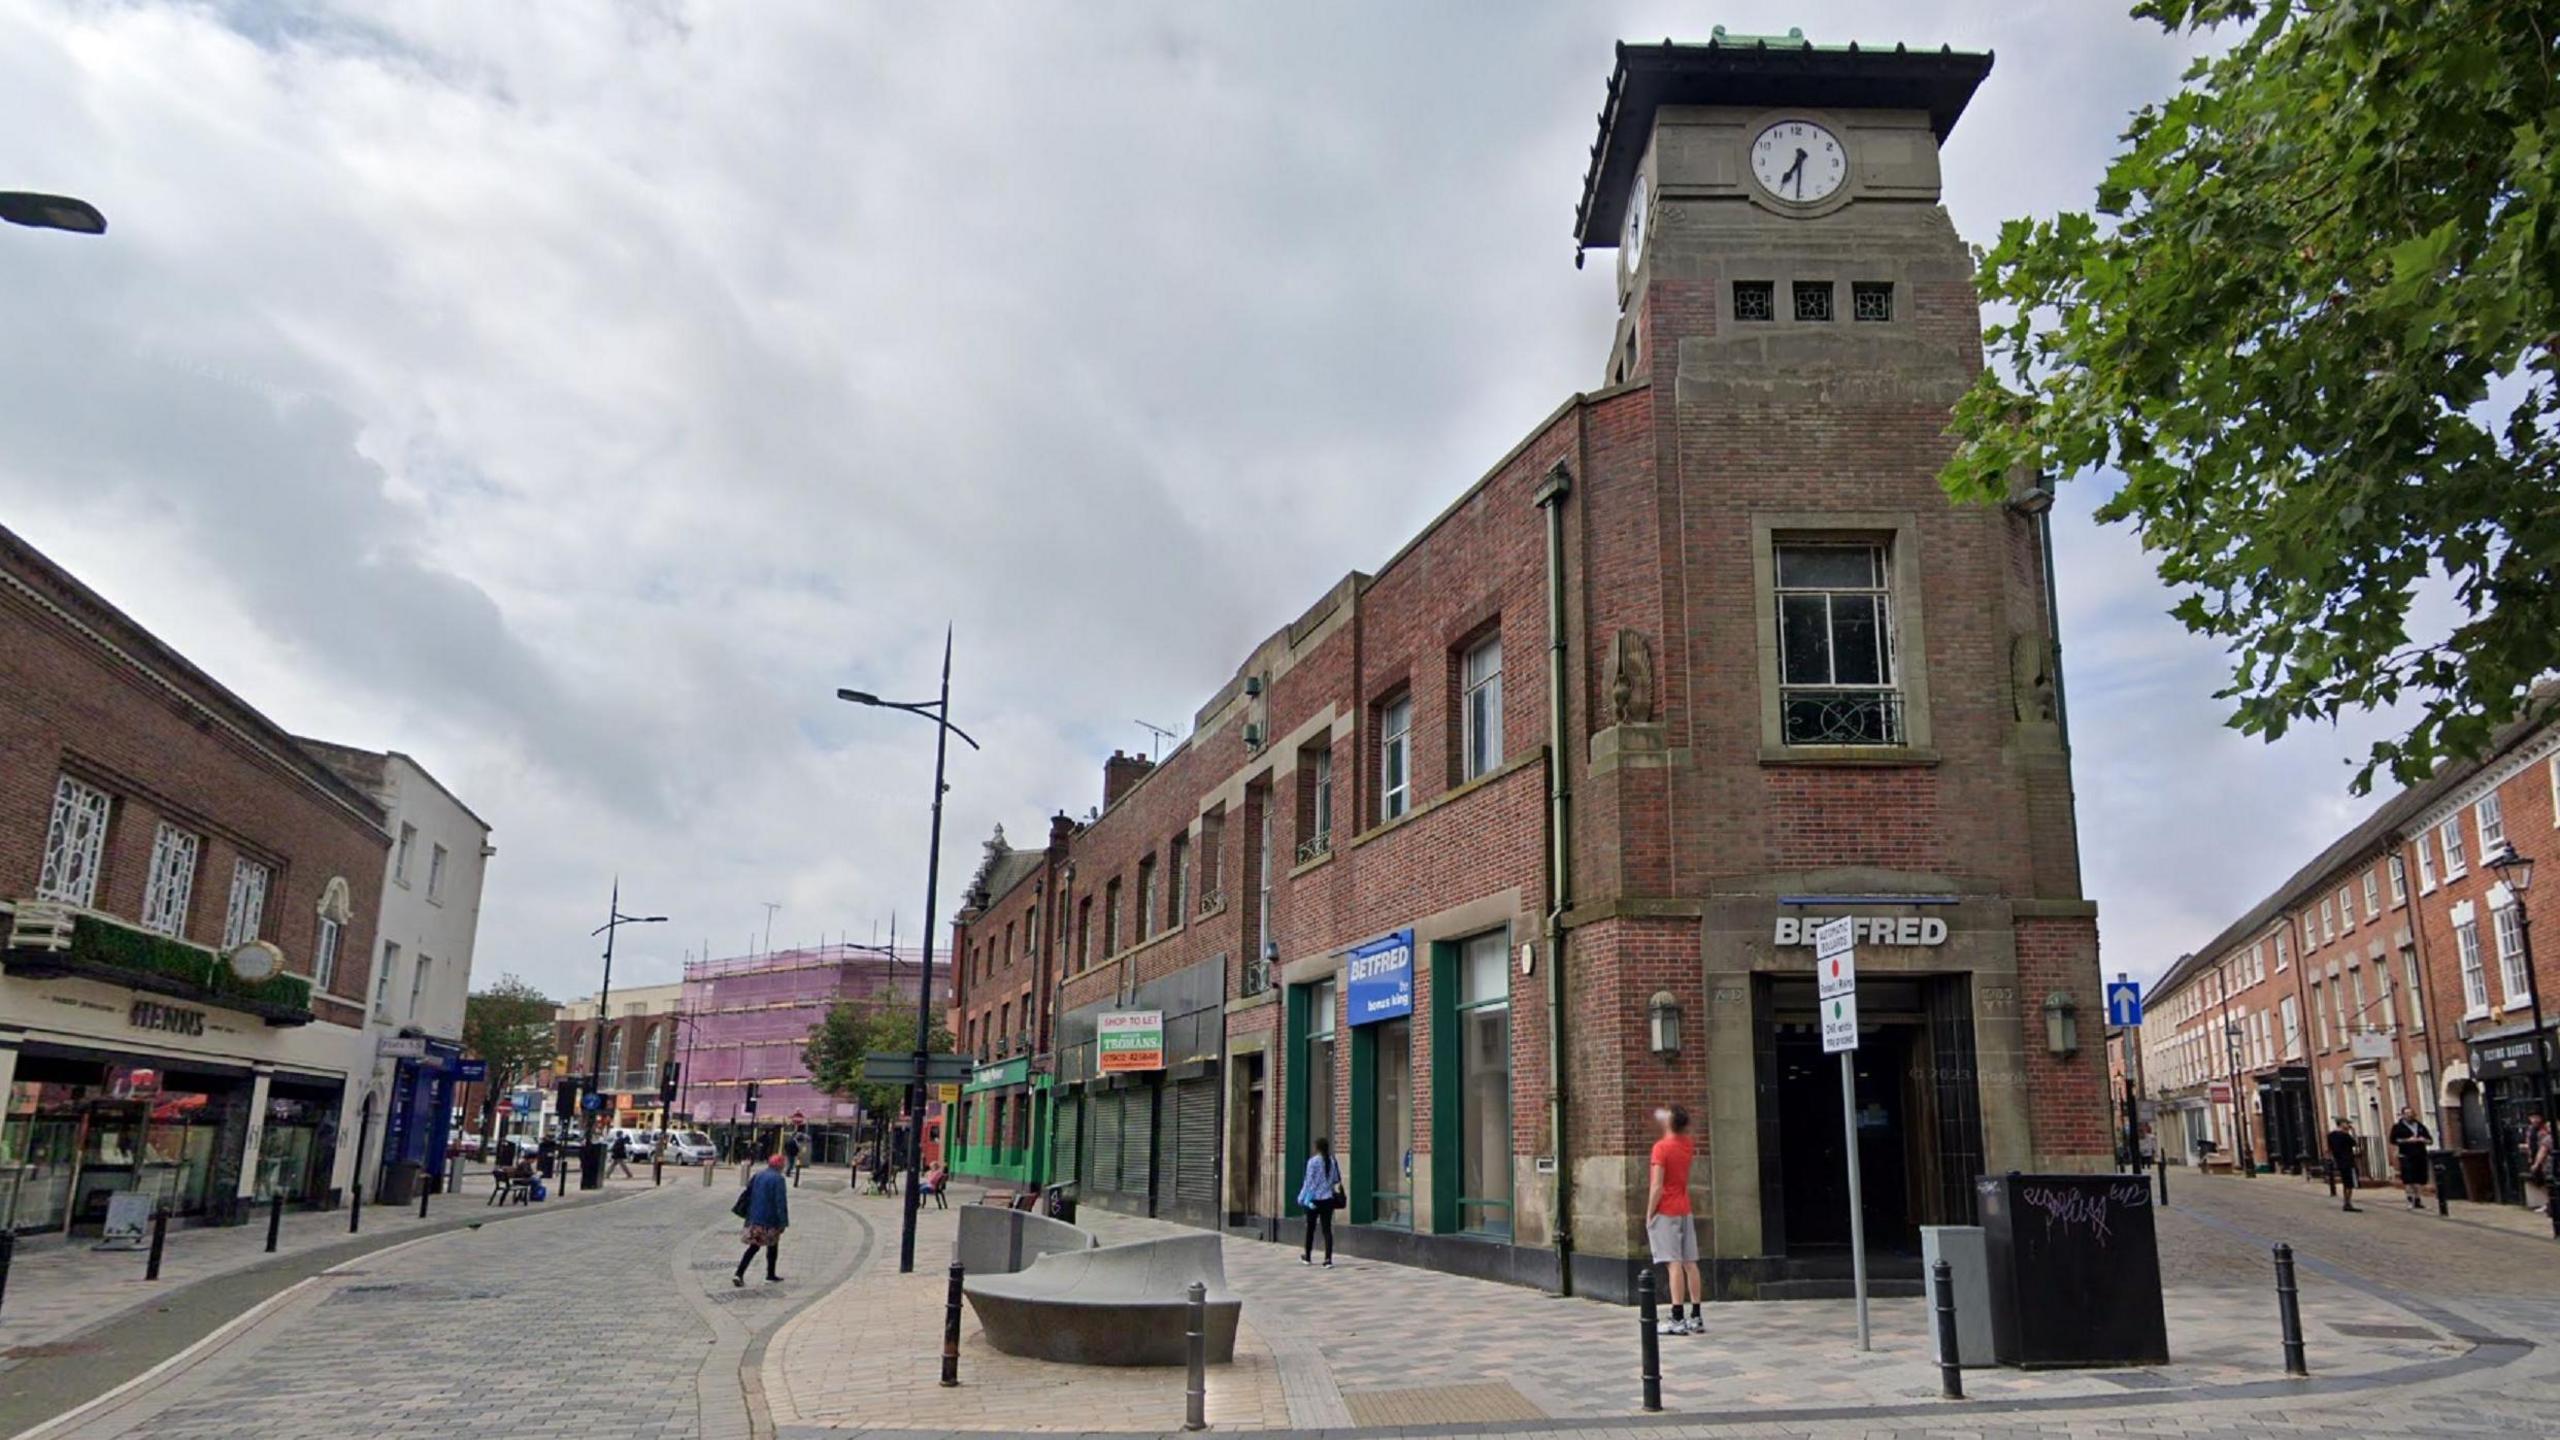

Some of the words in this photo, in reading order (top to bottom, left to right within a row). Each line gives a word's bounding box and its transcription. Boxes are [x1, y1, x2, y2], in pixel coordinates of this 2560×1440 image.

[1774, 917, 1948, 945] BEFRED
[1350, 945, 1408, 982] BETFRED
[1368, 998, 1390, 1011] bonus
[1392, 993, 1408, 1007] king
[130, 1000, 206, 1036] HENNS
[1104, 1017, 1127, 1027] SHOP
[1129, 1016, 1140, 1025] TO
[1143, 1016, 1159, 1025] LET
